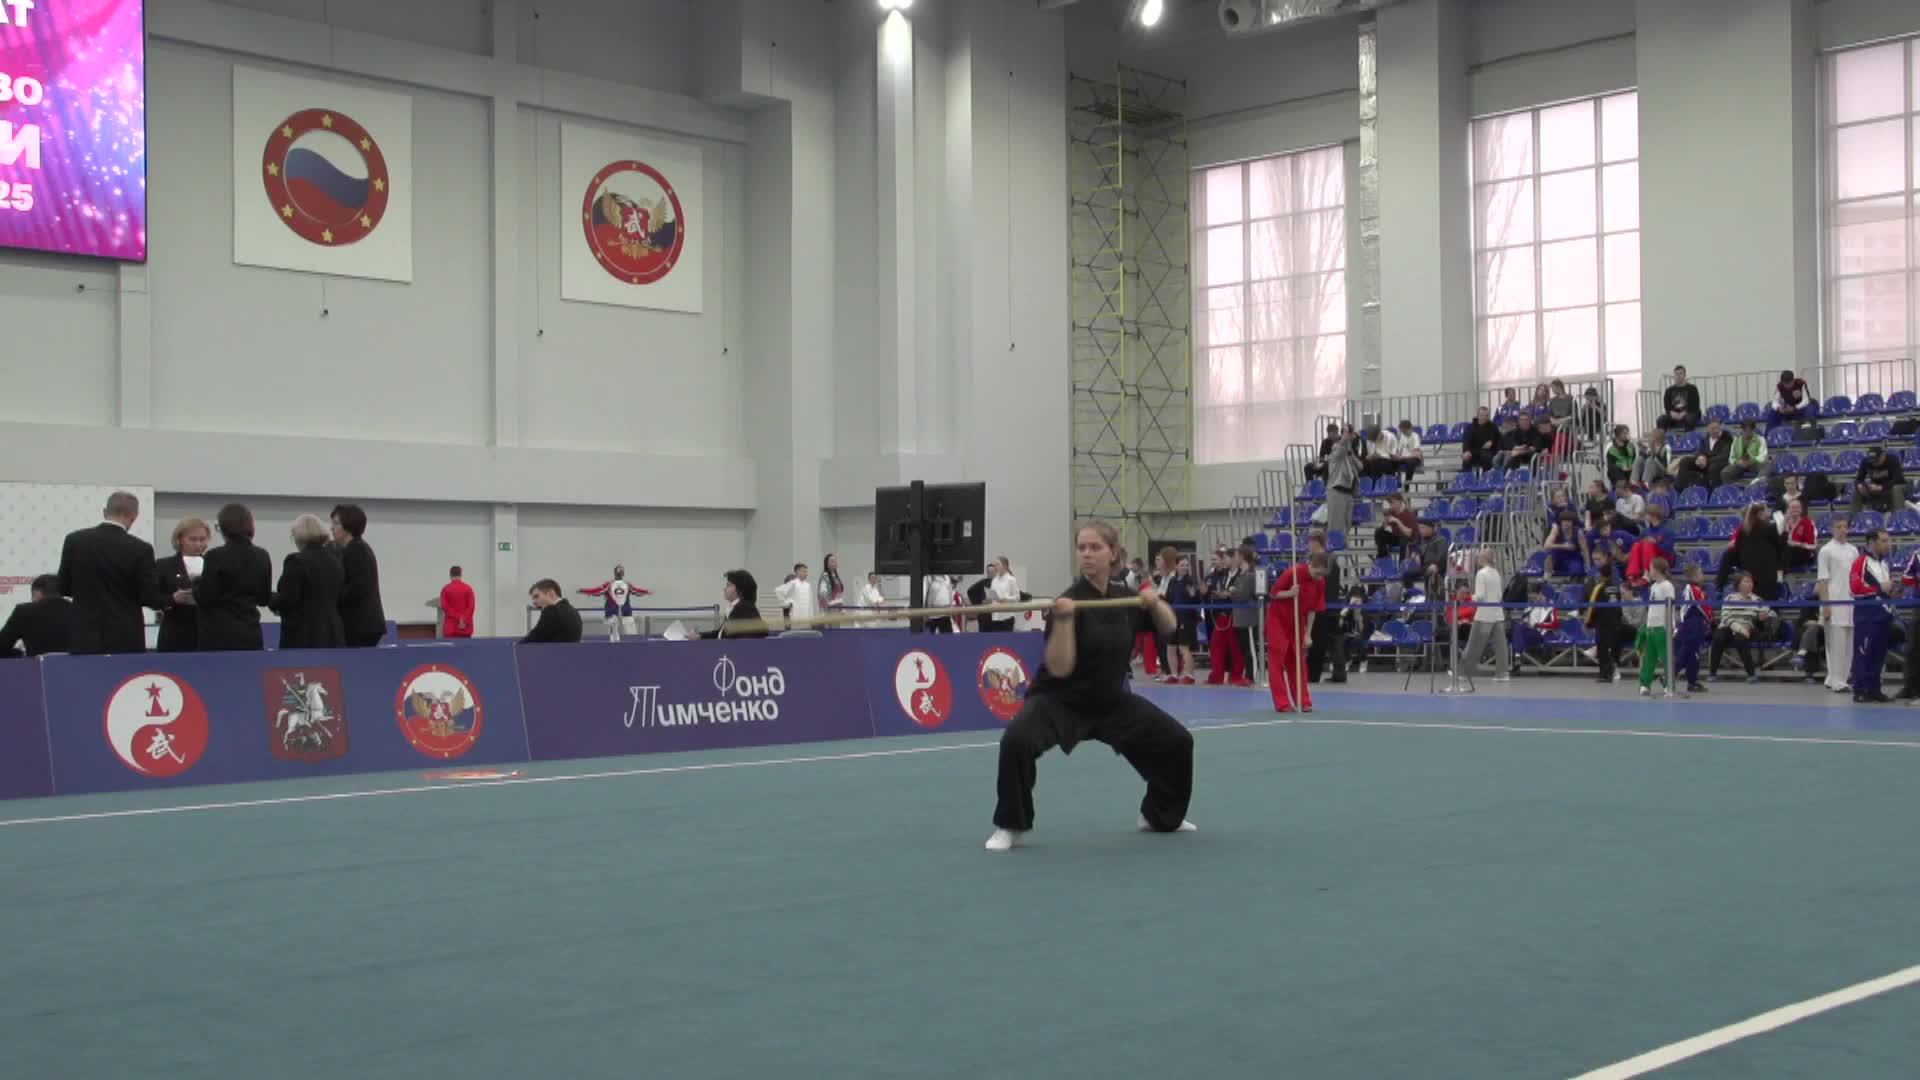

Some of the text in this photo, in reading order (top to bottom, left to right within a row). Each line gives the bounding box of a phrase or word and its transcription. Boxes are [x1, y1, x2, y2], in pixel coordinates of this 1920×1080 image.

[713, 654, 785, 698] Фонд
[624, 685, 780, 729] Тимченко
[145, 727, 187, 765] 武
